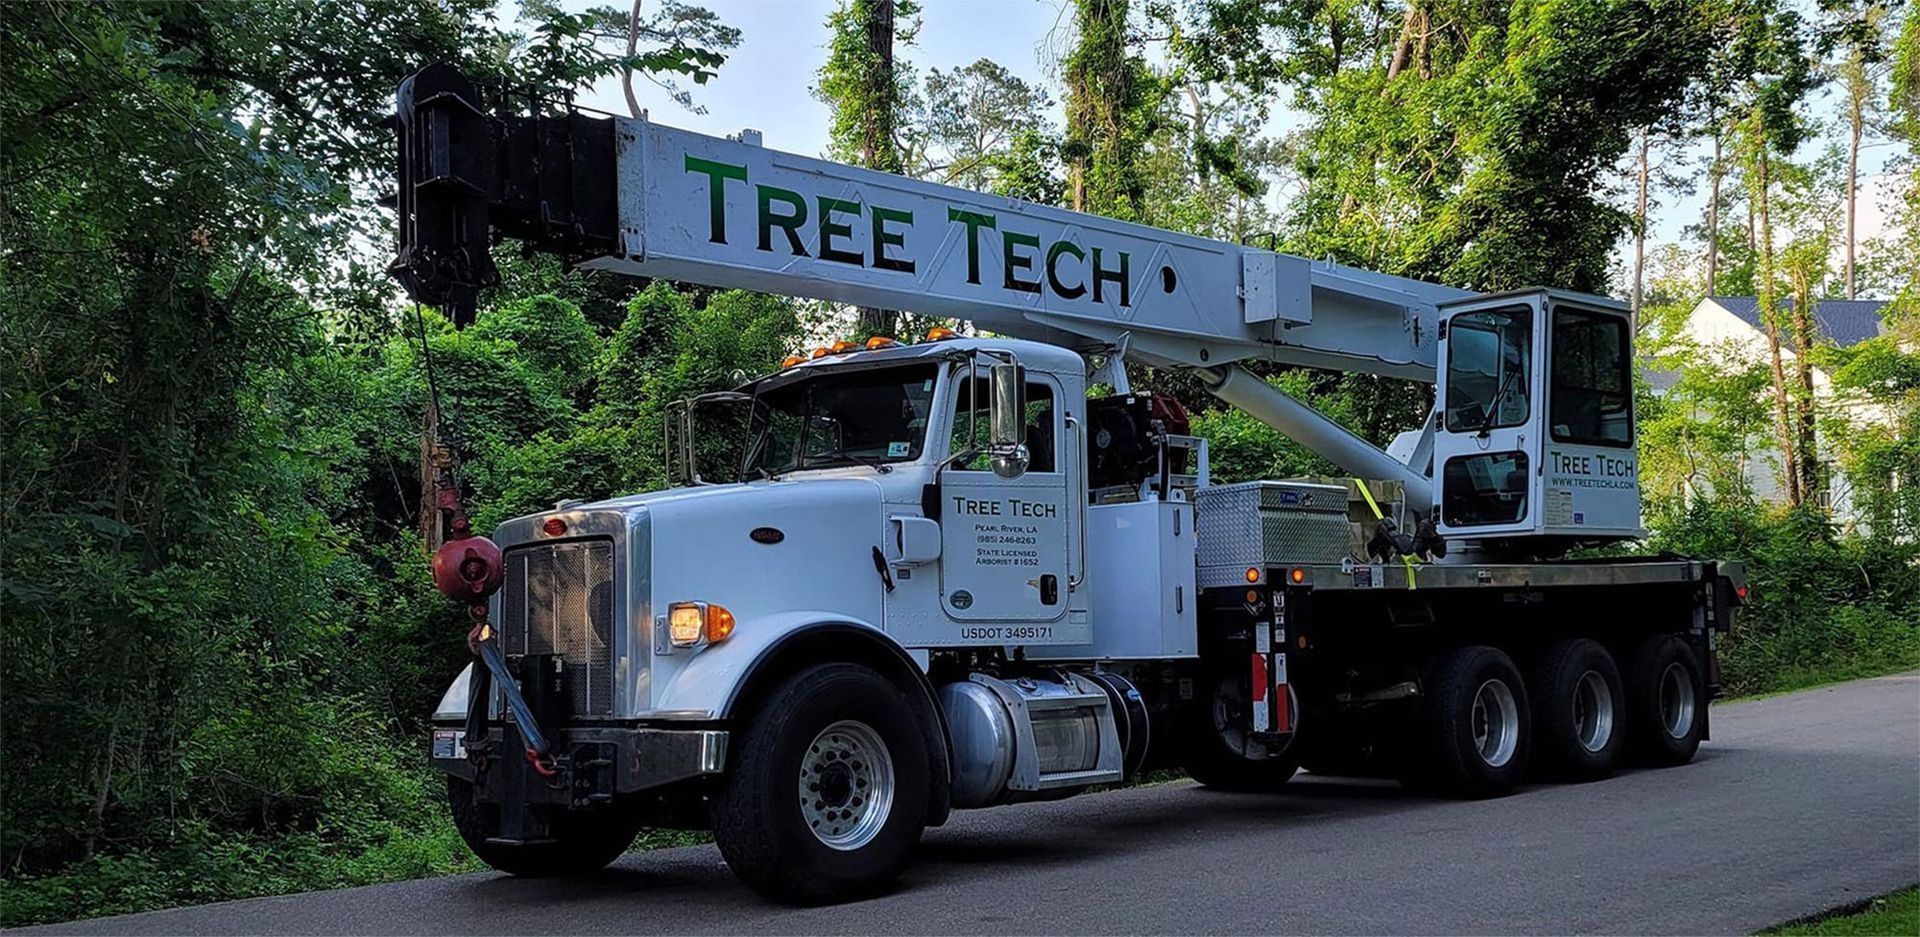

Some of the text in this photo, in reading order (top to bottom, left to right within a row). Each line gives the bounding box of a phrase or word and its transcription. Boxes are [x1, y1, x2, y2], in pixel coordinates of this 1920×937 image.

[684, 152, 1130, 307] TREE TECH
[1551, 451, 1634, 477] TREE TECH
[952, 496, 1056, 518] TREE TECH
[975, 524, 999, 532] PEARL
[976, 548, 1037, 557] STATE LICENSED
[961, 627, 1052, 639] USDOT 3495171
